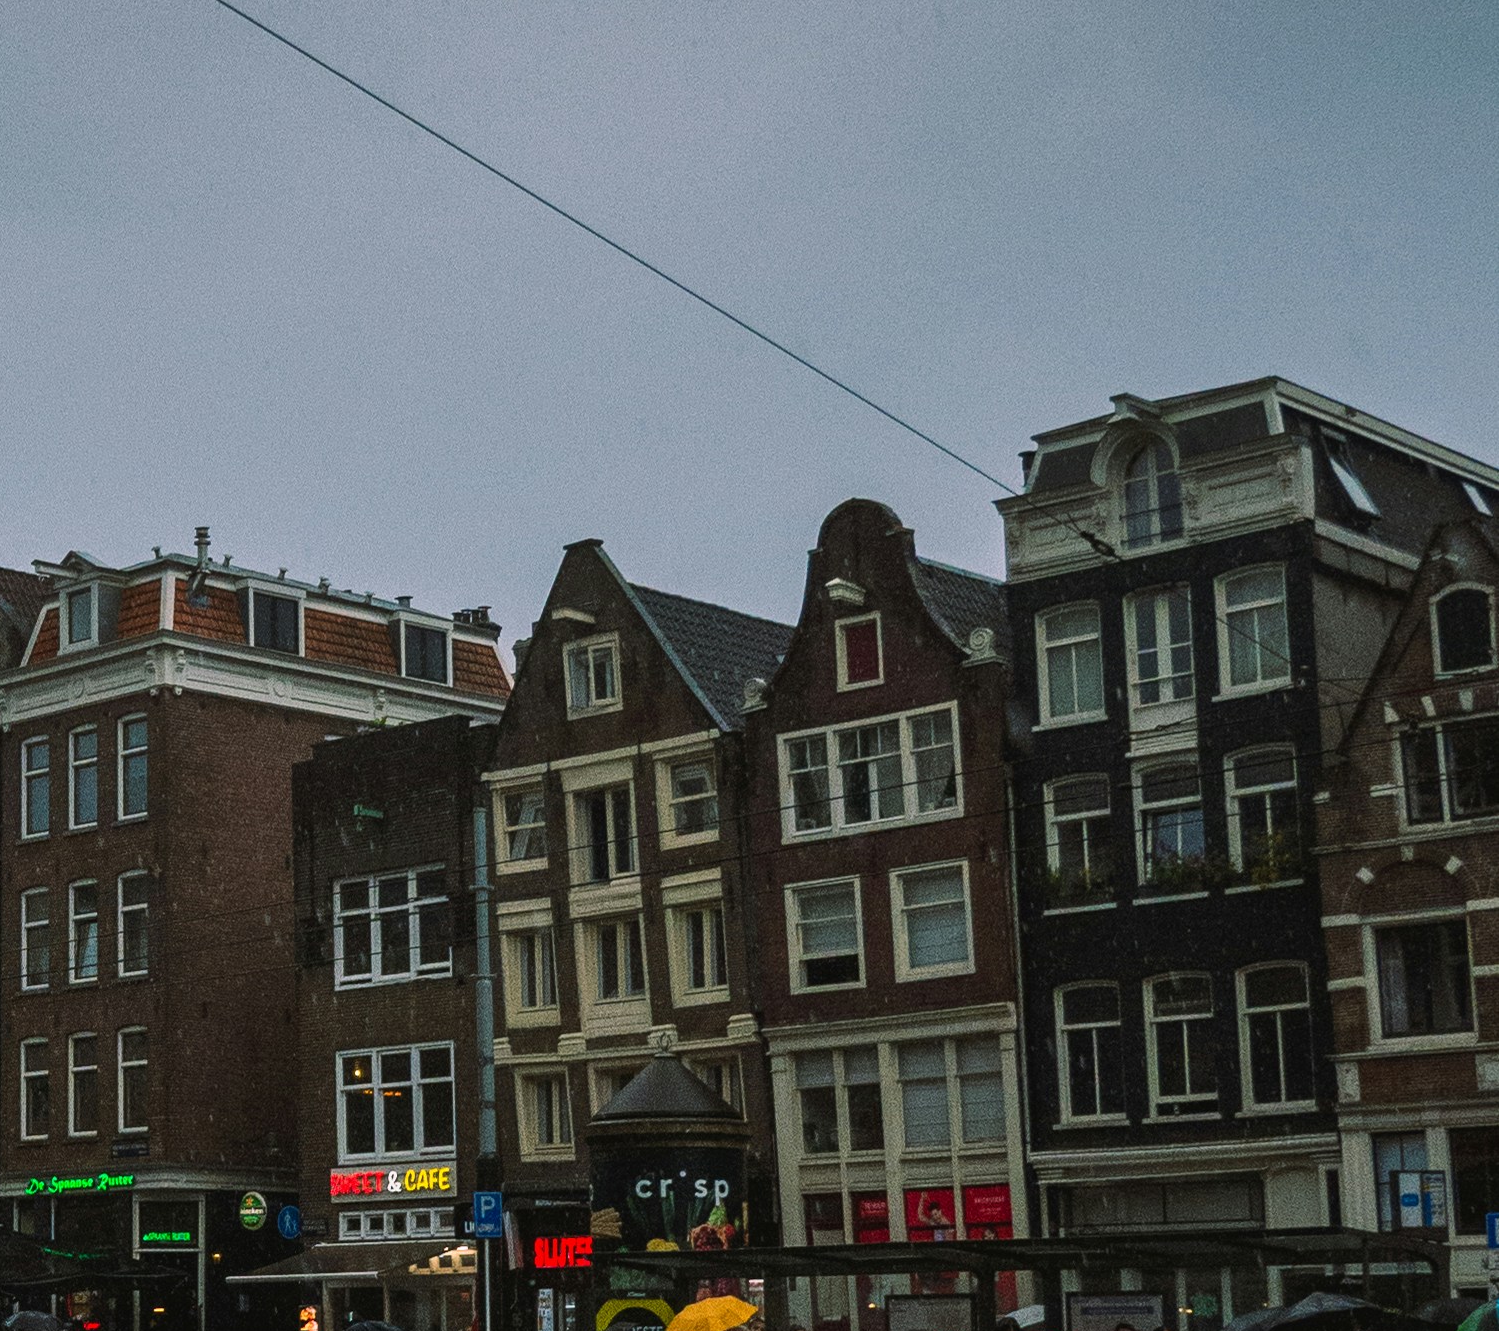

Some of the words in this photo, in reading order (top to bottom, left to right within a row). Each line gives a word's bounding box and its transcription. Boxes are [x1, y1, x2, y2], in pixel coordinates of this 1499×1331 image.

[25, 1177, 46, 1195] De
[48, 1175, 95, 1194] Spaanse
[96, 1172, 134, 1191] Ruiter
[387, 1171, 402, 1192] &
[404, 1167, 450, 1191] CAFE
[635, 1170, 730, 1207] crisp
[481, 1195, 496, 1219] P
